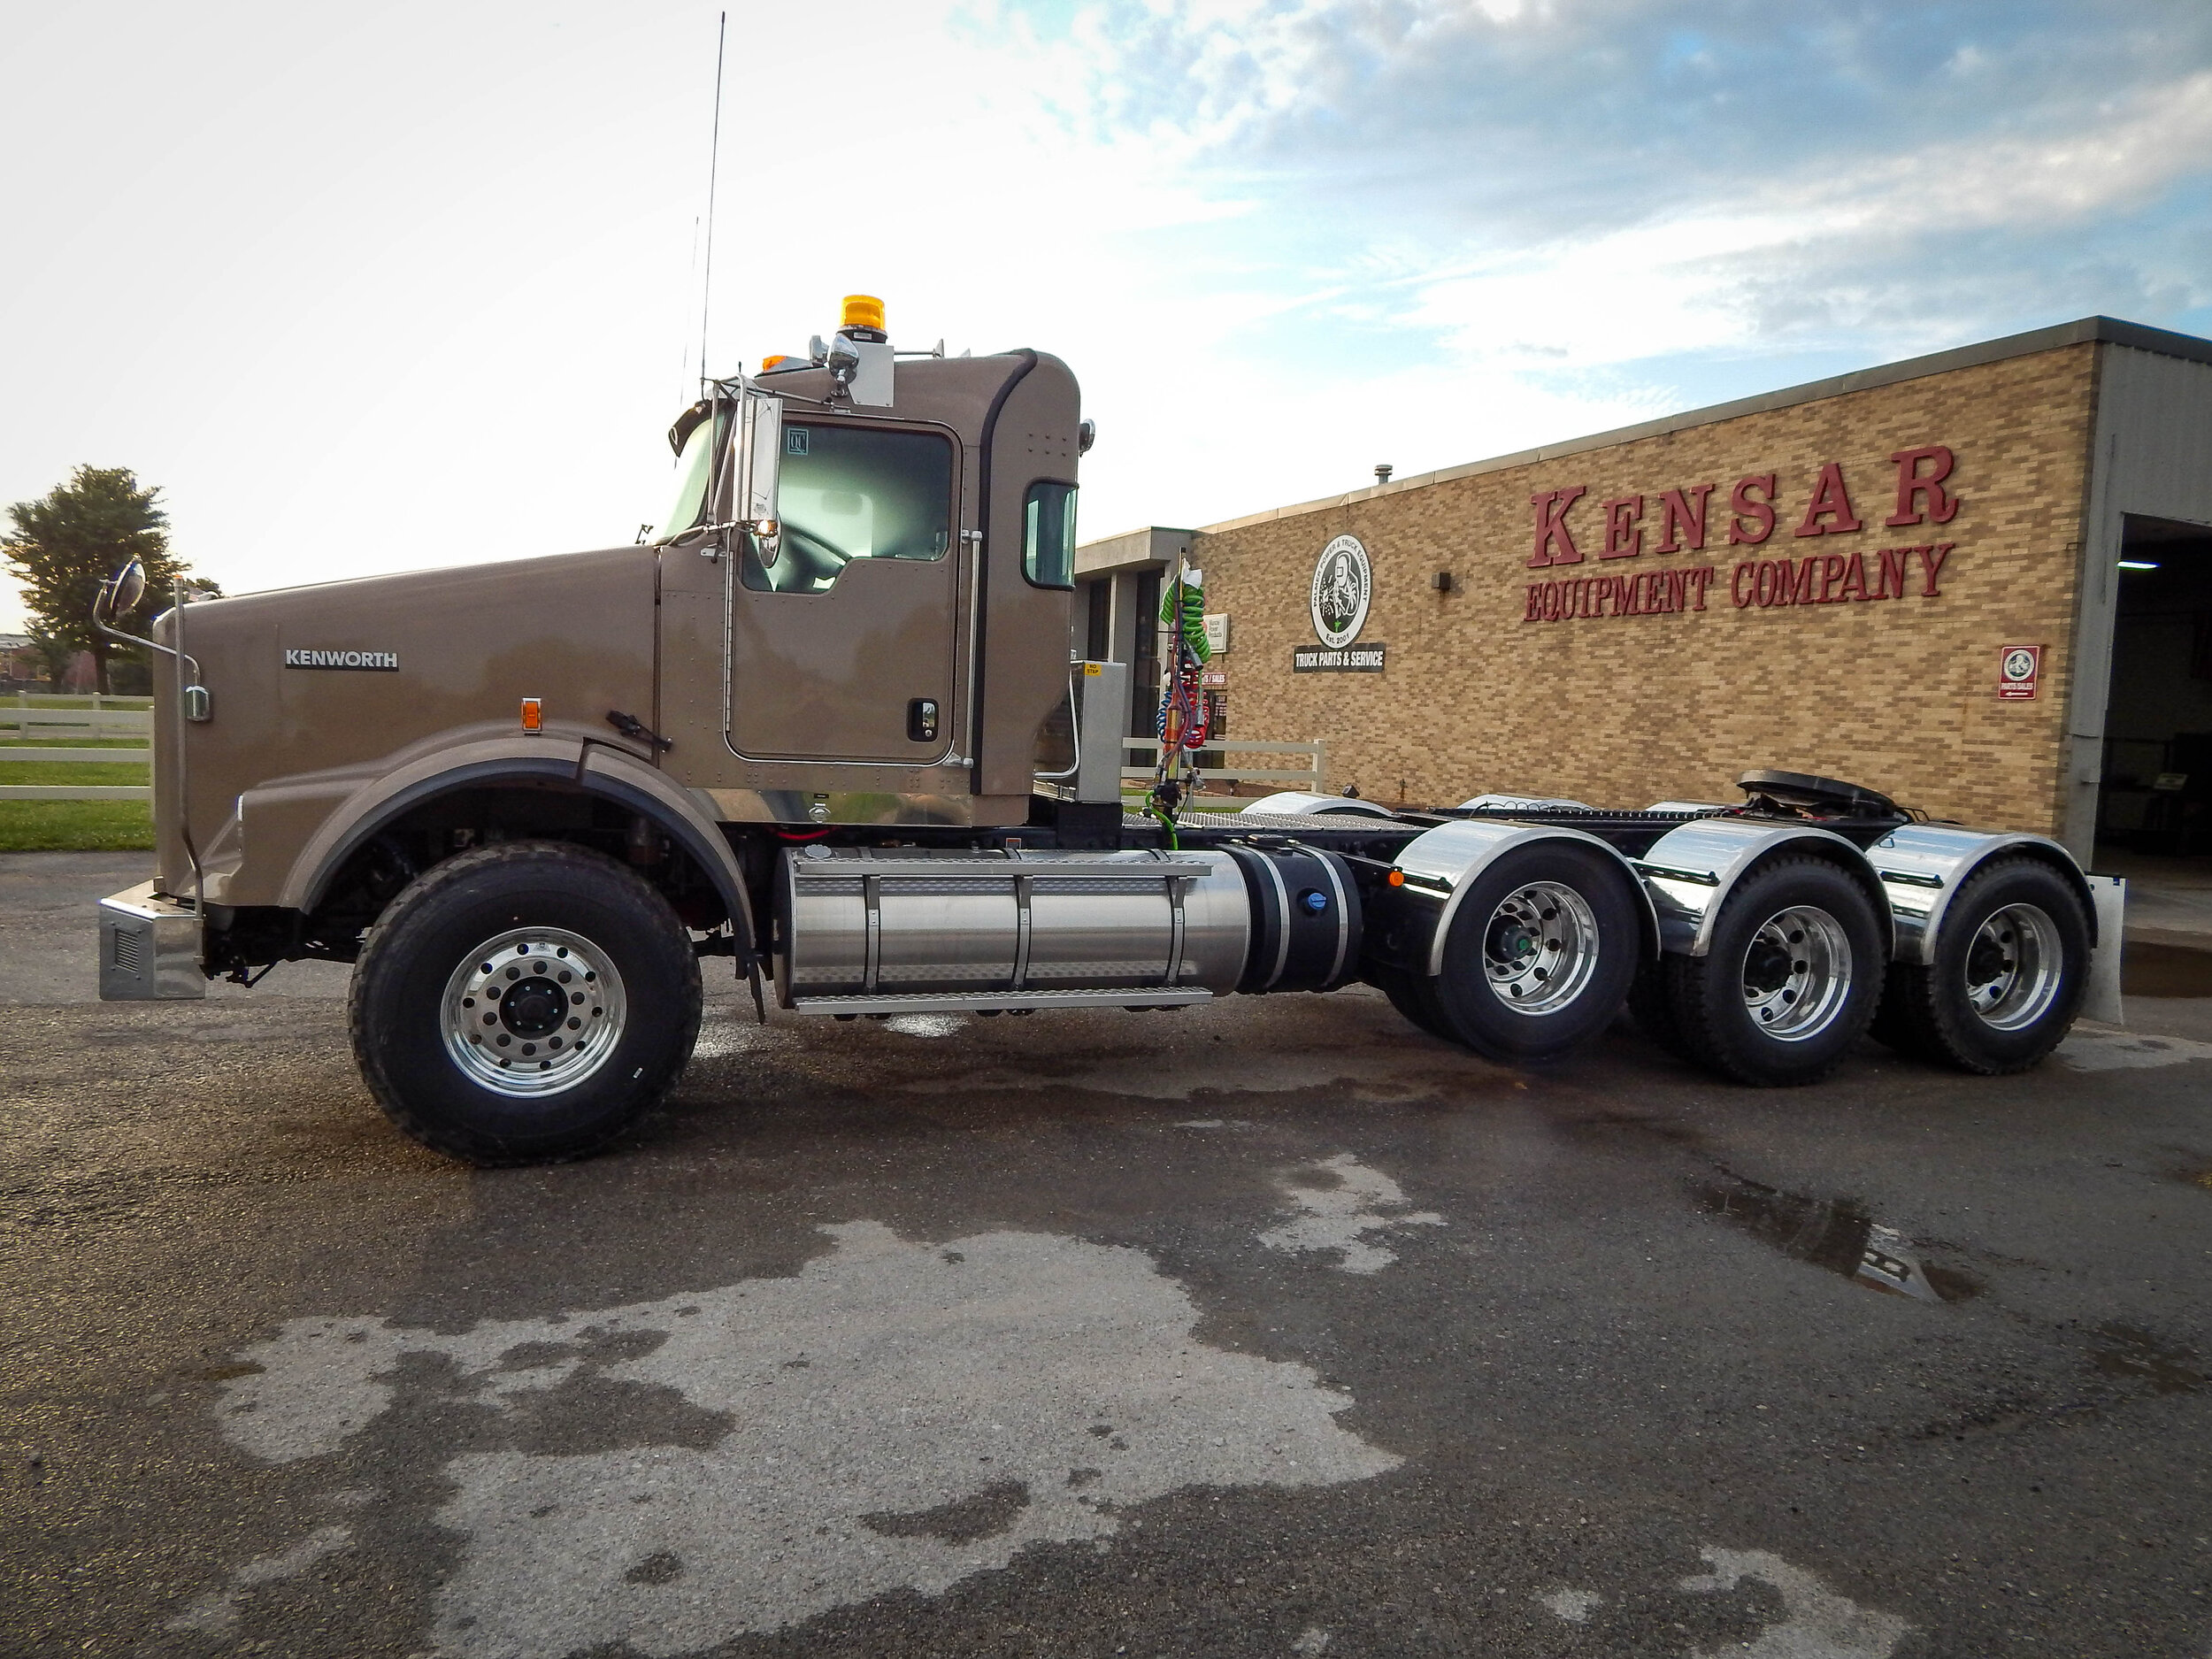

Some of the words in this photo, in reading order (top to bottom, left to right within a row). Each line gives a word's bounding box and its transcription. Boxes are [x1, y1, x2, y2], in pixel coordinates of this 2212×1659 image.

[1526, 445, 1959, 568] KENSAR
[1319, 544, 1336, 569] POWER
[1341, 539, 1358, 552] TRUCK
[1356, 549, 1369, 603] EQUIPMENT
[1524, 565, 1715, 622] EQUIPMENT
[1730, 541, 1956, 609] COMPANY
[1336, 633, 1349, 644] 2001
[286, 649, 397, 668] KENWORTH
[1295, 652, 1317, 667] TRUCK
[1318, 650, 1342, 666] PARTS
[1343, 650, 1349, 666] &
[1350, 650, 1384, 666] SERVICE
[1211, 674, 1225, 683] SALES
